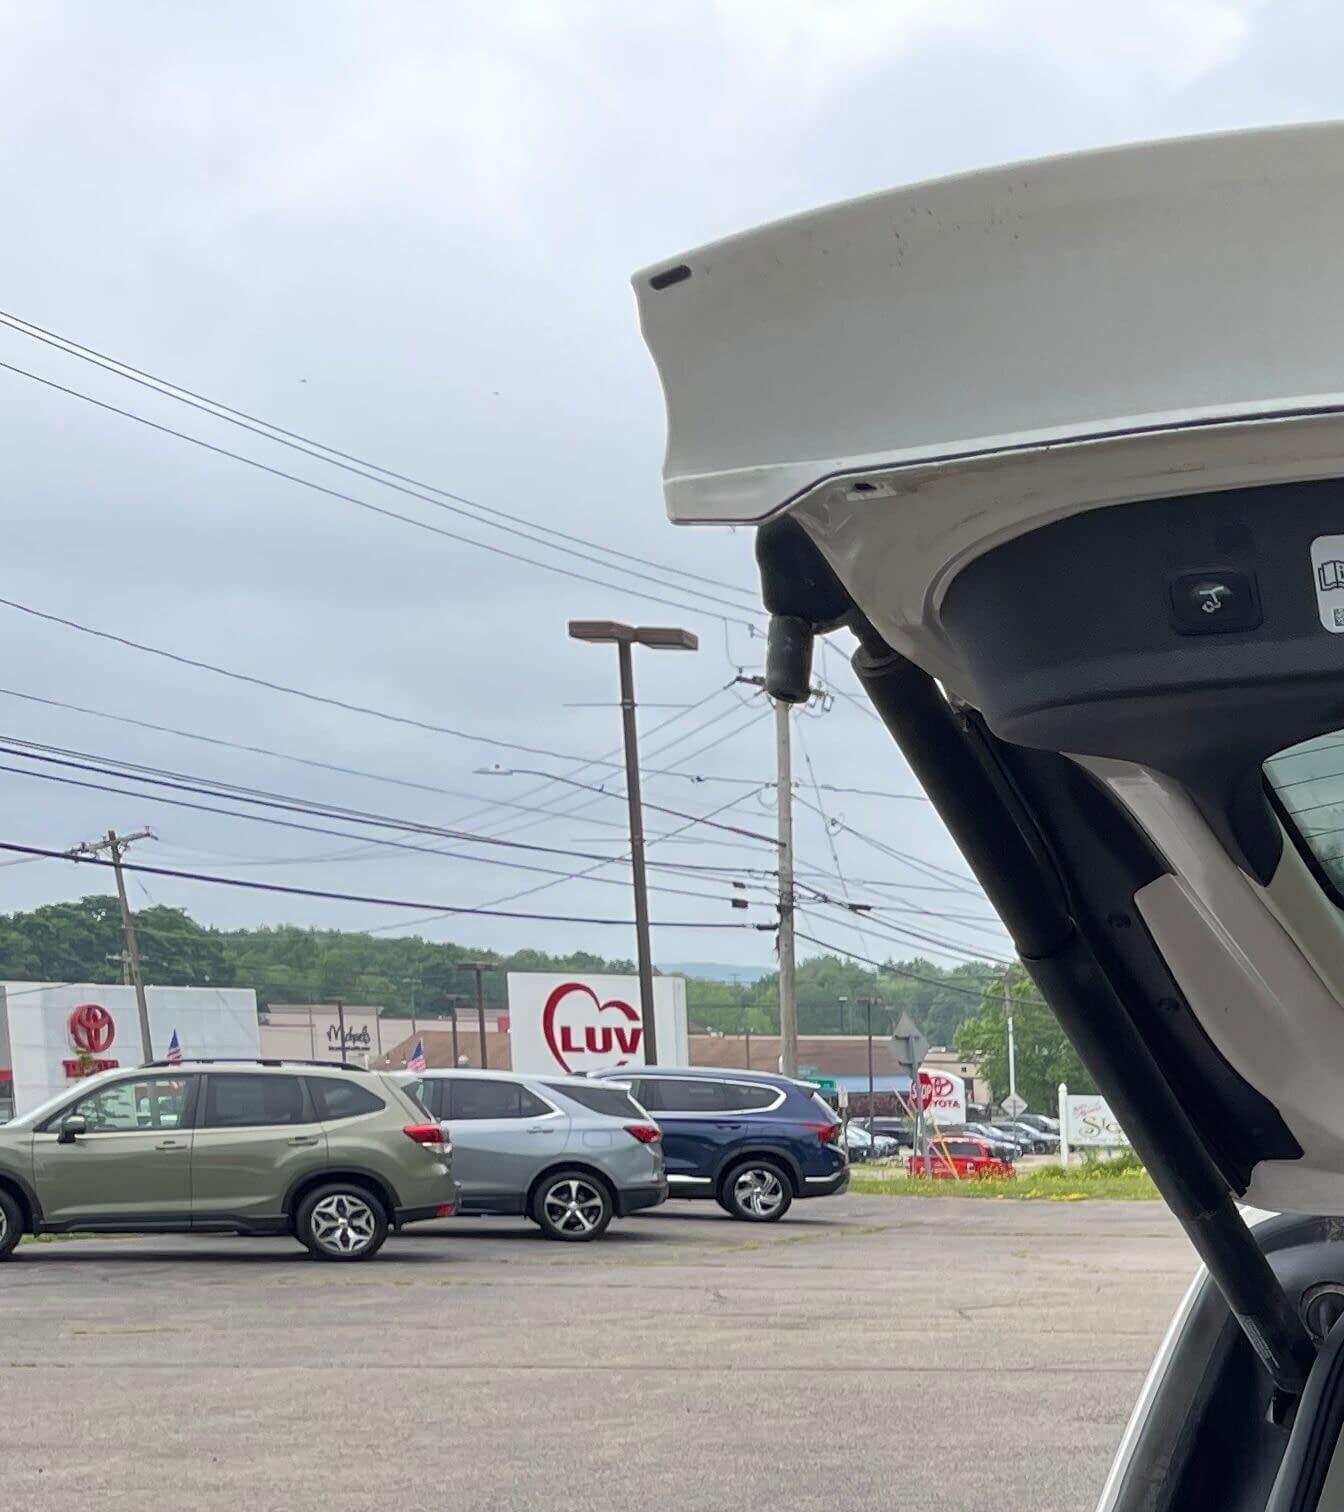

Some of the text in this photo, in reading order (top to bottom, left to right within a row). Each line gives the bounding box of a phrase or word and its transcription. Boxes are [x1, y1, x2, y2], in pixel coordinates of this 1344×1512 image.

[560, 1025, 644, 1054] LUV
[911, 1083, 932, 1099] SOP
[934, 1100, 961, 1108] YOTA
